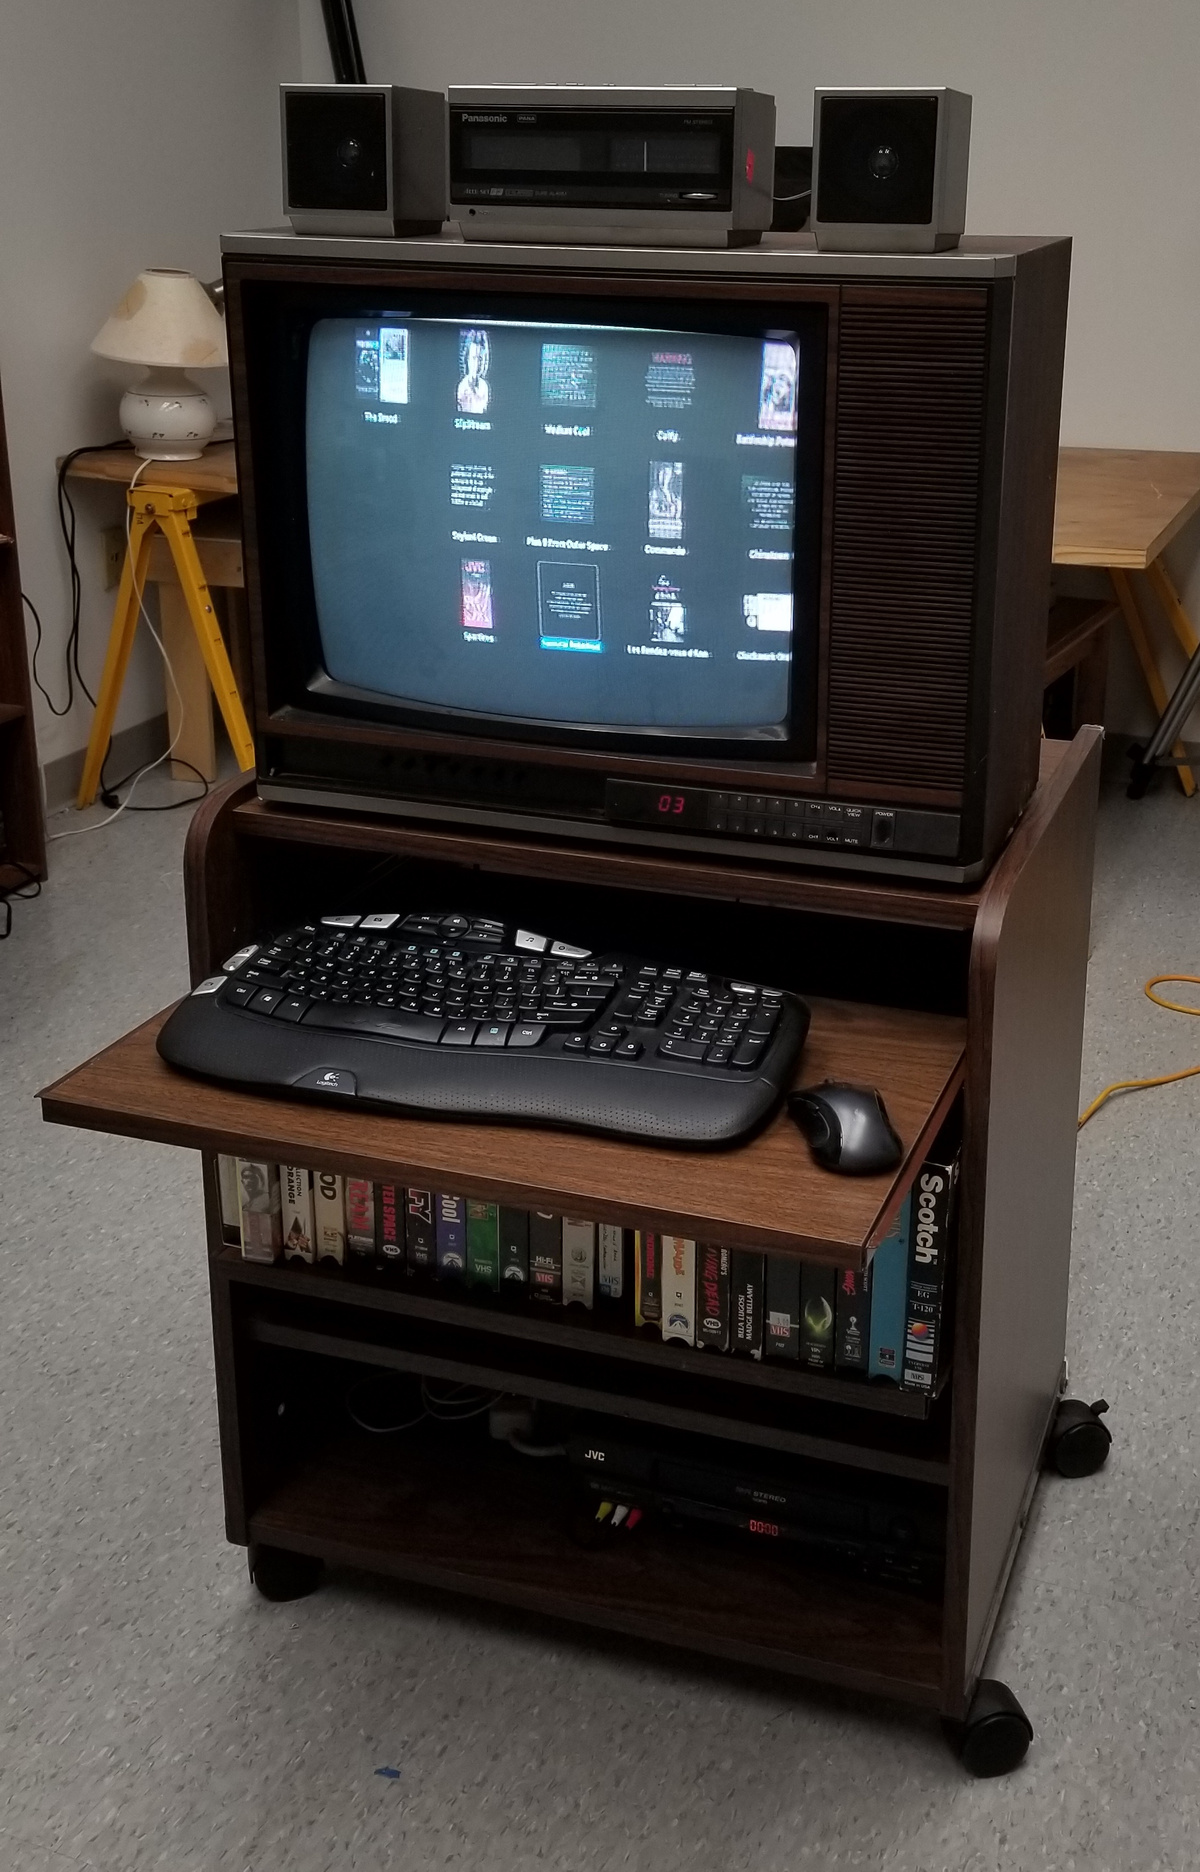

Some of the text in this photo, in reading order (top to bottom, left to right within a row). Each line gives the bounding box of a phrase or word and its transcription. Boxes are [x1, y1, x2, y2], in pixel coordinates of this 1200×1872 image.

[462, 114, 508, 123] Panasonic
[658, 795, 685, 814] 03
[316, 1079, 338, 1087] Logitech
[383, 1206, 396, 1241] SPACE
[915, 1173, 943, 1264] Scotch
[475, 1264, 492, 1273] VHS
[536, 1272, 554, 1283] VHS
[703, 1281, 720, 1316] DEAD
[917, 1290, 930, 1299] EG
[913, 1303, 933, 1313] T-120
[772, 1326, 789, 1336] VHS
[584, 1450, 605, 1462] JVC
[753, 1491, 787, 1502] STEREO
